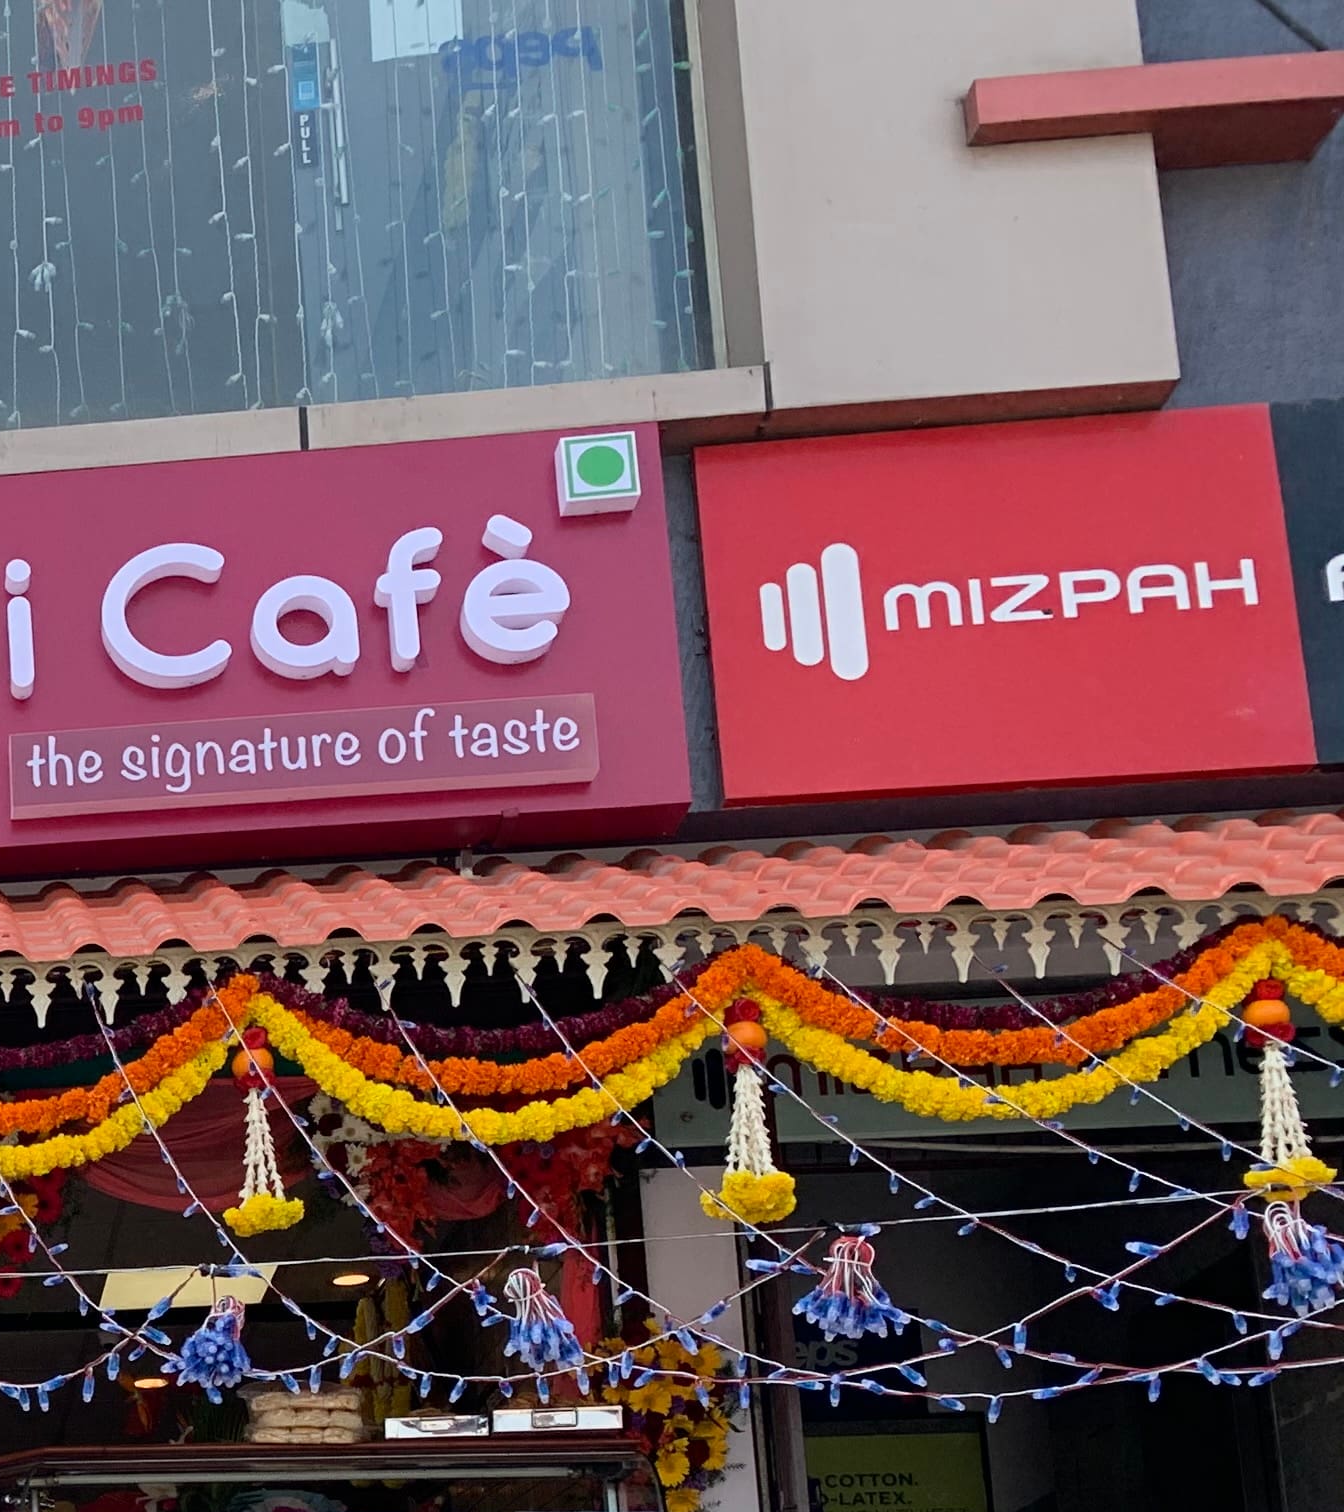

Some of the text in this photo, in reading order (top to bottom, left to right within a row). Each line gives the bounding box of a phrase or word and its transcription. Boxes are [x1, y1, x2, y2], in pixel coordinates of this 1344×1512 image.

[27, 59, 158, 95] TIMINGS
[34, 112, 64, 134] to
[77, 104, 144, 131] 9pm
[299, 113, 312, 164] PULL
[100, 514, 571, 690] Cafè
[26, 706, 581, 793] the signature of taste
[824, 1472, 919, 1488] COTTON.
